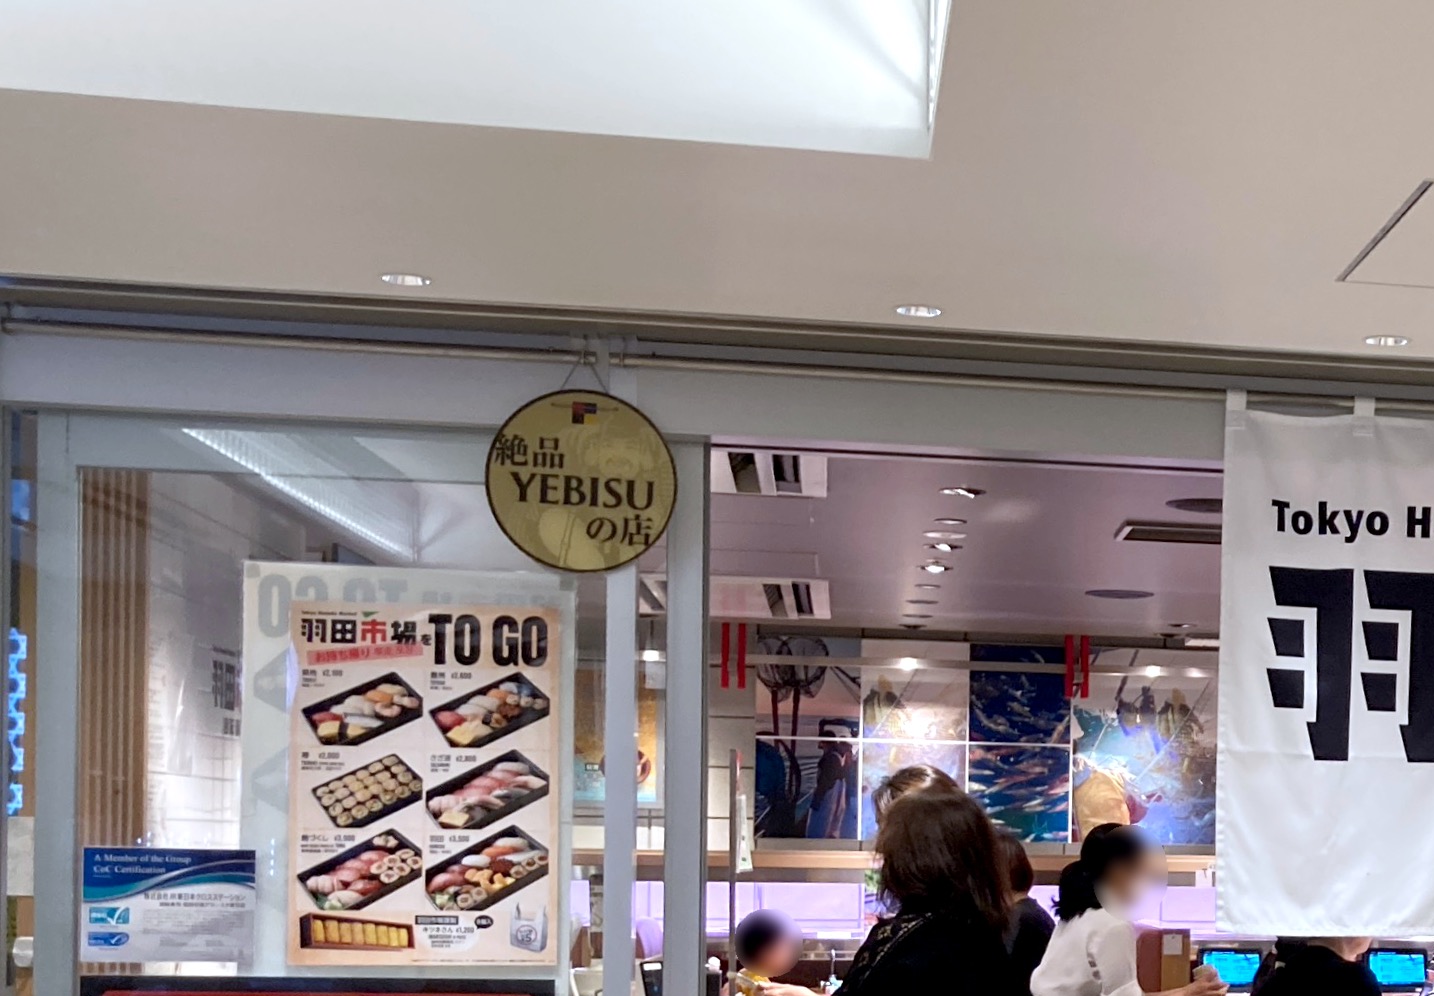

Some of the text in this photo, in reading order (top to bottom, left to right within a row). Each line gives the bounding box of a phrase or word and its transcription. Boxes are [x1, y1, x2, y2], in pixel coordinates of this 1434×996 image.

[495, 434, 564, 469] 絶品
[510, 472, 654, 510] YEBISU
[586, 514, 653, 546] の店
[1272, 500, 1387, 545] Tokyo
[428, 613, 480, 665] TO
[492, 615, 549, 667] GO
[104, 854, 137, 863] Member
[140, 854, 149, 863] of
[151, 854, 164, 863] the
[165, 855, 192, 865] Group
[115, 866, 166, 874] Certification
